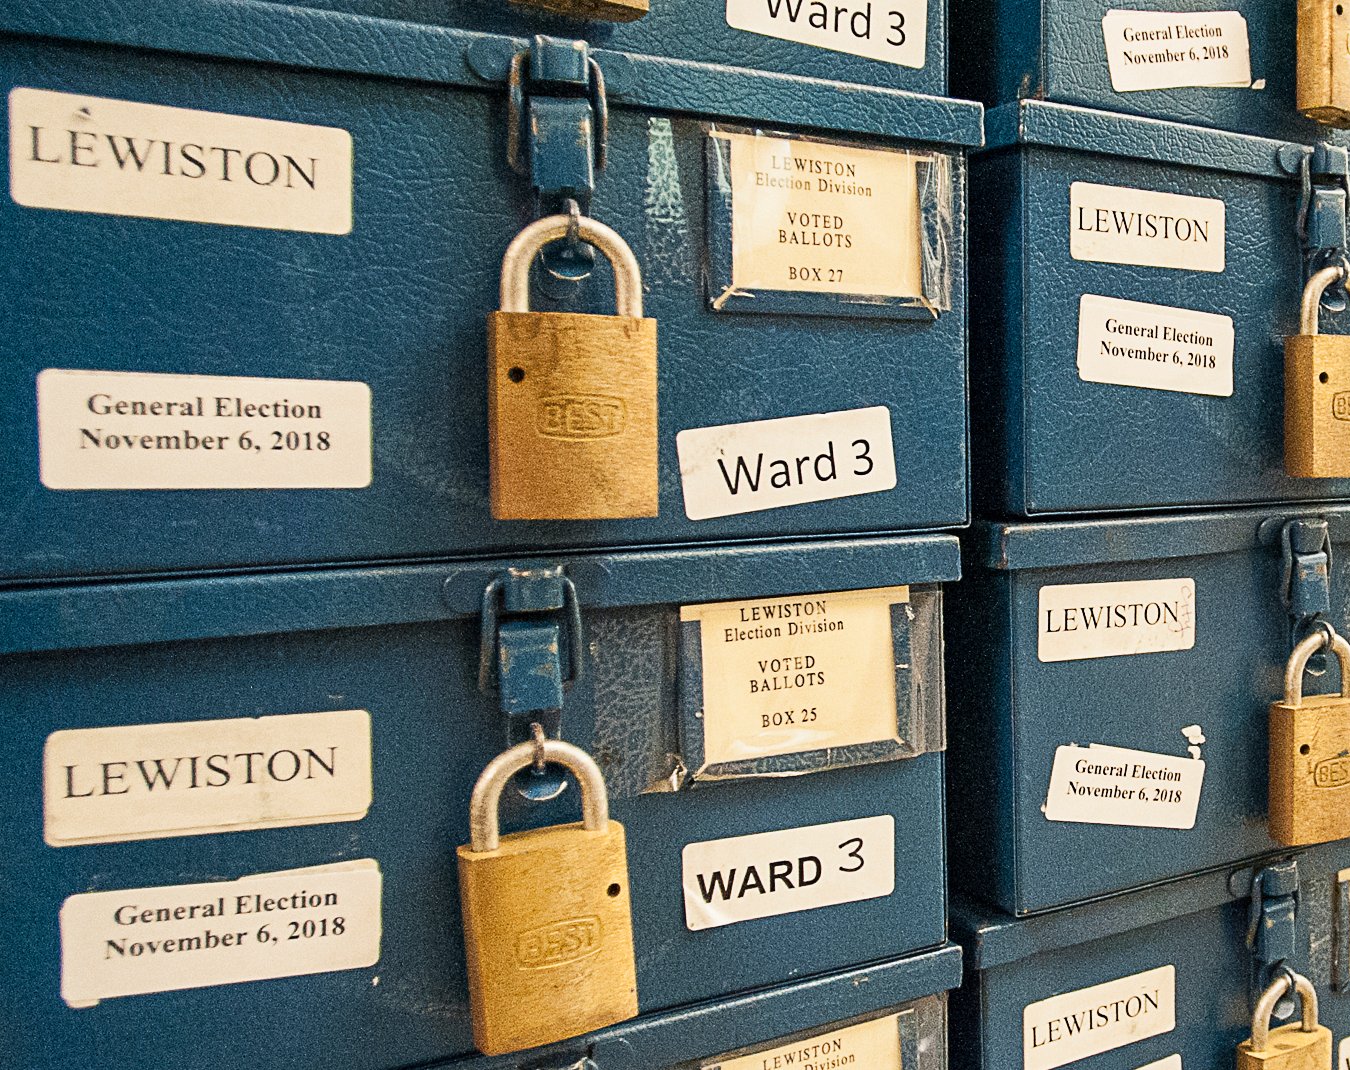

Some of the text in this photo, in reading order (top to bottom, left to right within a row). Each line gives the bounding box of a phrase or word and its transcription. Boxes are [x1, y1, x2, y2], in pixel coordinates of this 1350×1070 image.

[766, 0, 906, 46] Ward 3
[1123, 24, 1222, 43] General Election
[1123, 45, 1229, 66] November 6, 2018
[28, 125, 319, 190] LEWISTON
[772, 155, 856, 177] LEWISTON
[755, 172, 872, 197] Election Division
[787, 211, 843, 230] VOTED
[1078, 207, 1210, 243] LEWISTON
[778, 229, 852, 248] BALLOTS
[789, 267, 843, 283] BOX 27
[1105, 318, 1213, 347] General Election
[1100, 340, 1216, 369] November 6, 2018
[87, 393, 322, 419] General Election
[543, 400, 619, 432] BEST
[80, 428, 331, 454] November 6, 2018
[717, 439, 874, 495] Ward 3
[740, 600, 827, 622] LEWISTON
[1046, 601, 1179, 633] LEWISTON
[724, 619, 844, 643] Election Division
[758, 655, 815, 673] VOTED
[750, 672, 825, 693] BALLOTS
[761, 707, 817, 728] BOX 25
[62, 745, 340, 799] LEWISTON
[1075, 759, 1182, 782] General Election
[1066, 781, 1182, 804] November 6, 2018
[697, 837, 865, 904] WARD 3
[113, 890, 339, 927] General Election
[104, 916, 346, 961] November 6, 2018
[1032, 990, 1160, 1048] LEWISTON
[763, 1038, 842, 1070] LEWISTON
